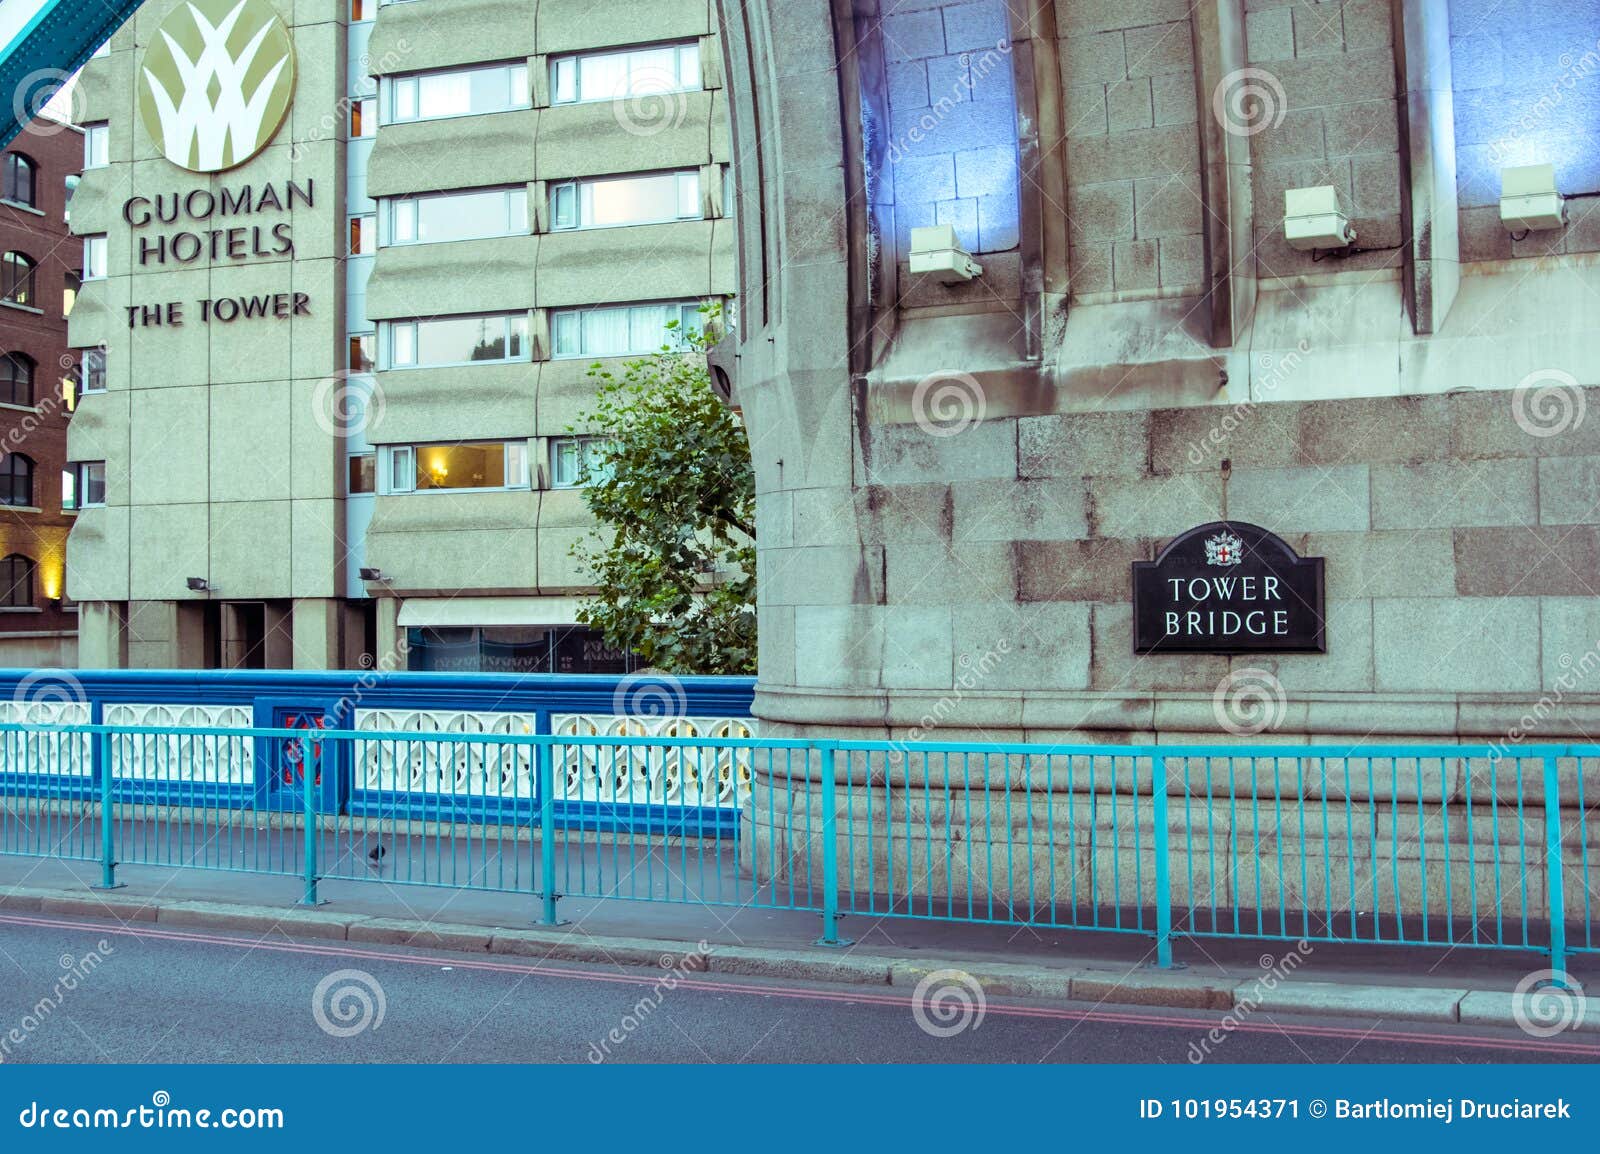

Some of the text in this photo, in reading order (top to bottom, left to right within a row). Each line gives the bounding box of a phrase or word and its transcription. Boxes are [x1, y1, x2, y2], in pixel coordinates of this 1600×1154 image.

[122, 178, 314, 227] GUOMAN
[139, 223, 294, 265] HOTELS
[124, 292, 311, 330] THE TOWER
[1168, 576, 1281, 601] TOWER
[1165, 611, 1288, 635] BRIDGE
